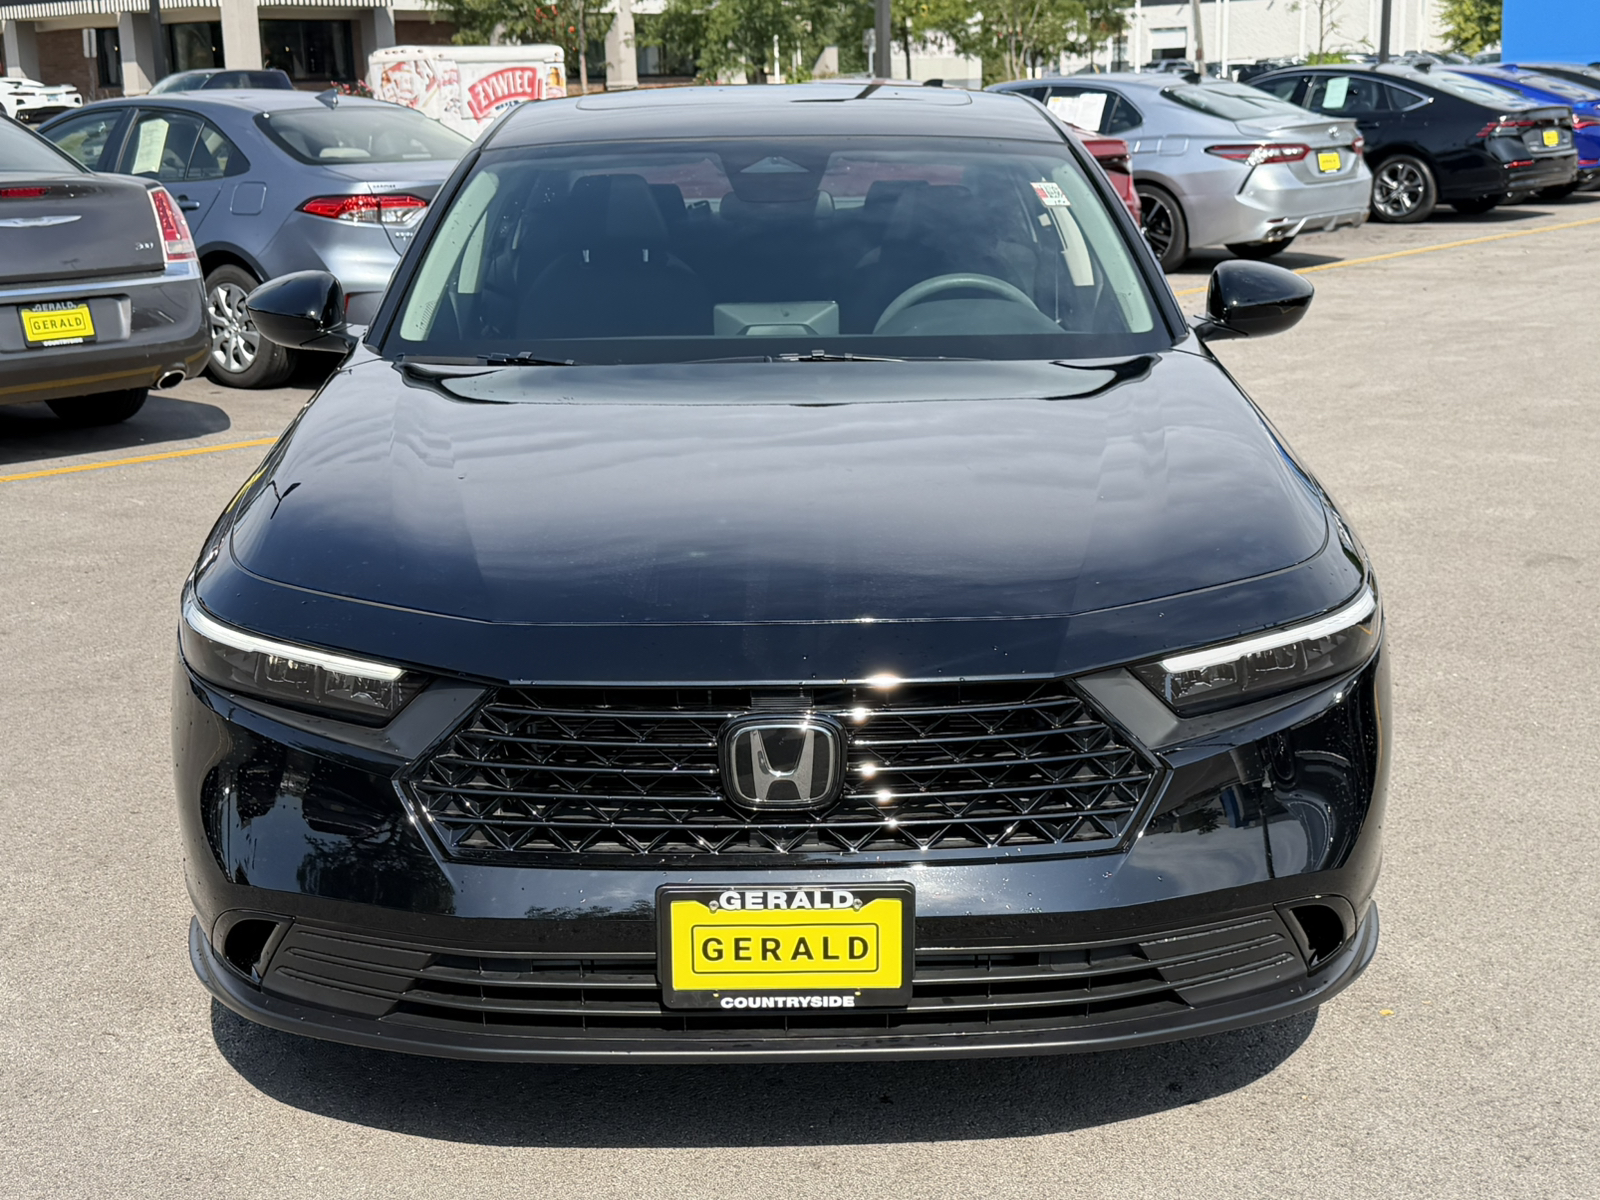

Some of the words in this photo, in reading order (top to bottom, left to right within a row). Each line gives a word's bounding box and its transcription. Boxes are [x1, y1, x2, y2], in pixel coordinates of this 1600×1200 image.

[33, 317, 82, 330] GERALD
[719, 891, 854, 910] GERALD
[702, 936, 869, 962] GERALD
[720, 996, 855, 1009] COUNTRYSIDE
